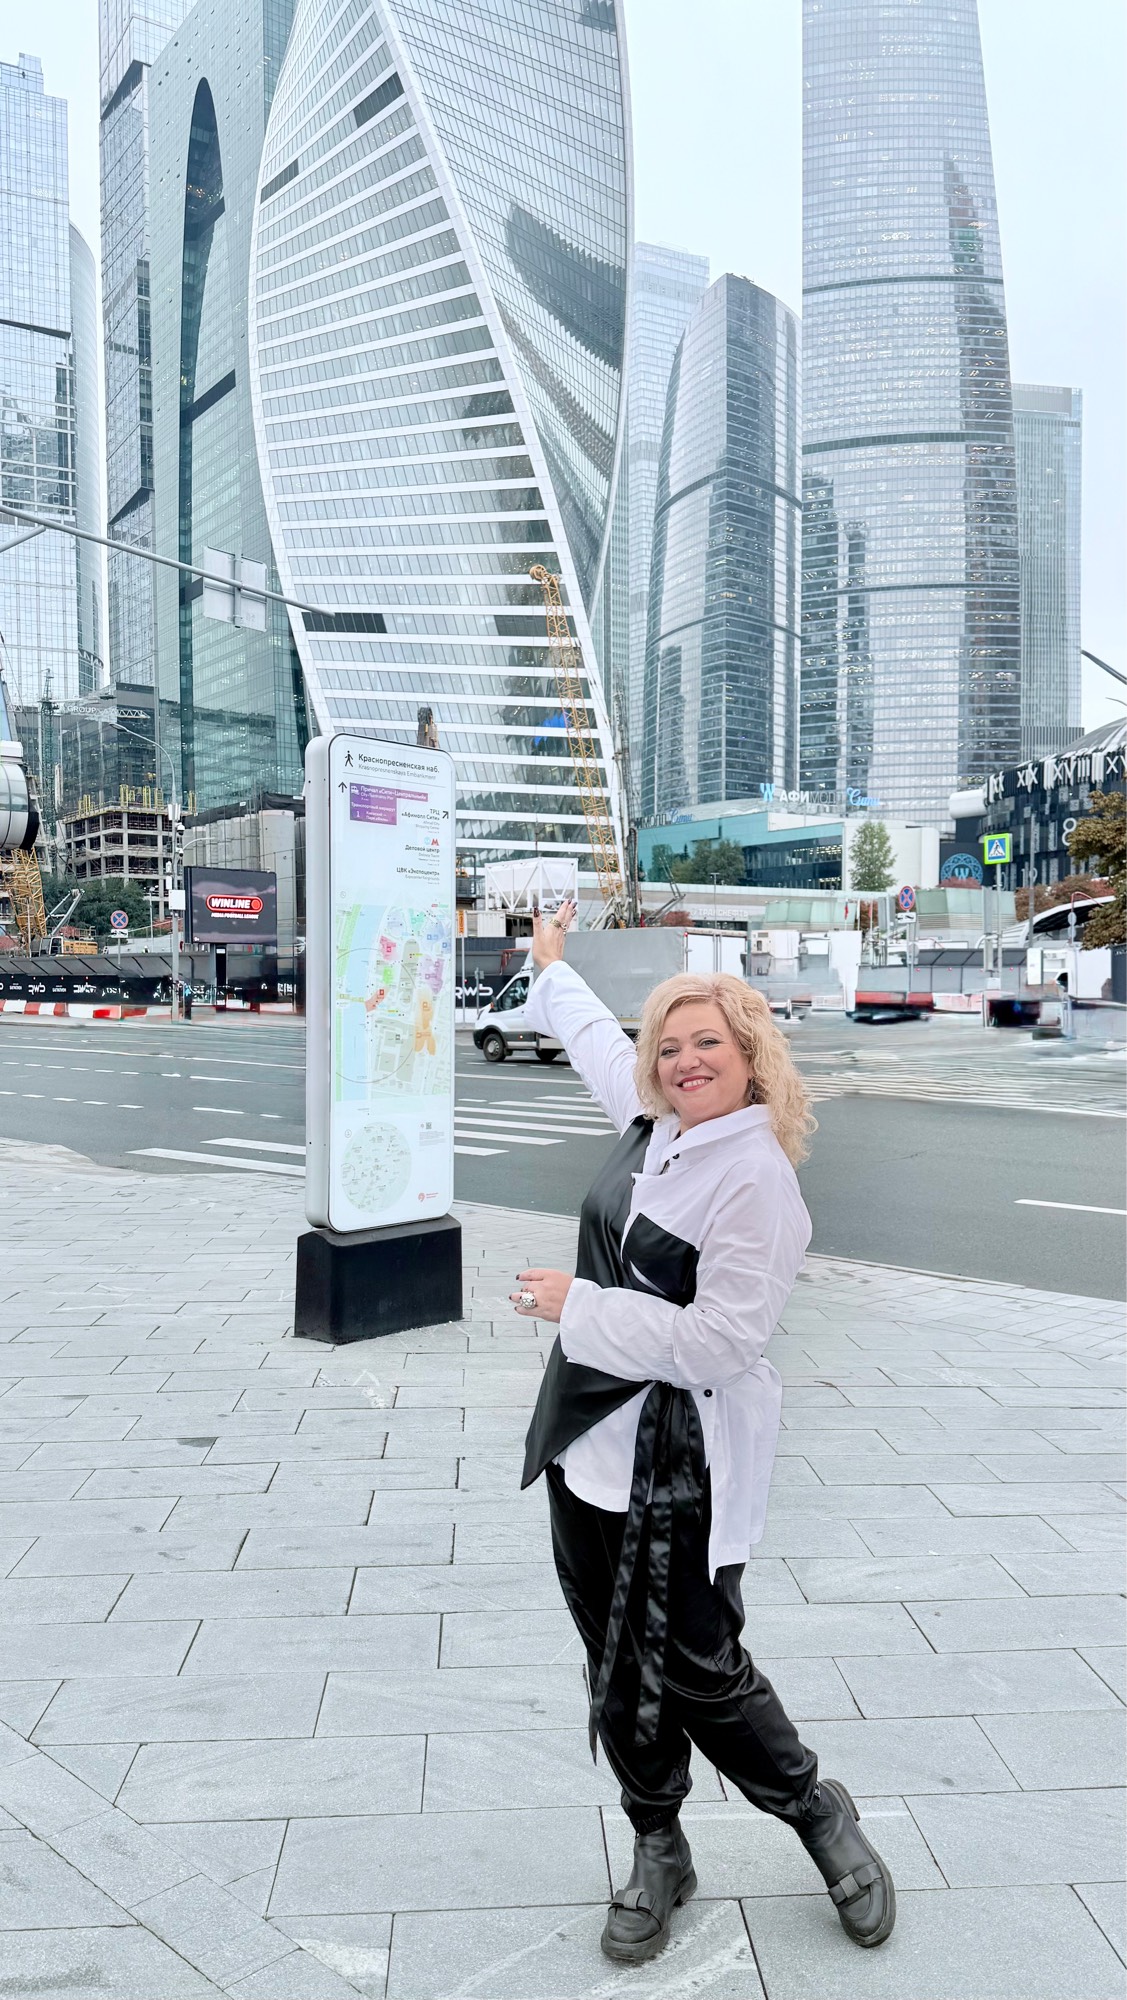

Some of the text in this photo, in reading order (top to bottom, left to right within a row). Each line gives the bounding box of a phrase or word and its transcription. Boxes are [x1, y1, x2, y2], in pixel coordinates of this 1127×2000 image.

[358, 753, 440, 774] Краснопресненская наб.
[210, 897, 252, 909] WINLINE
